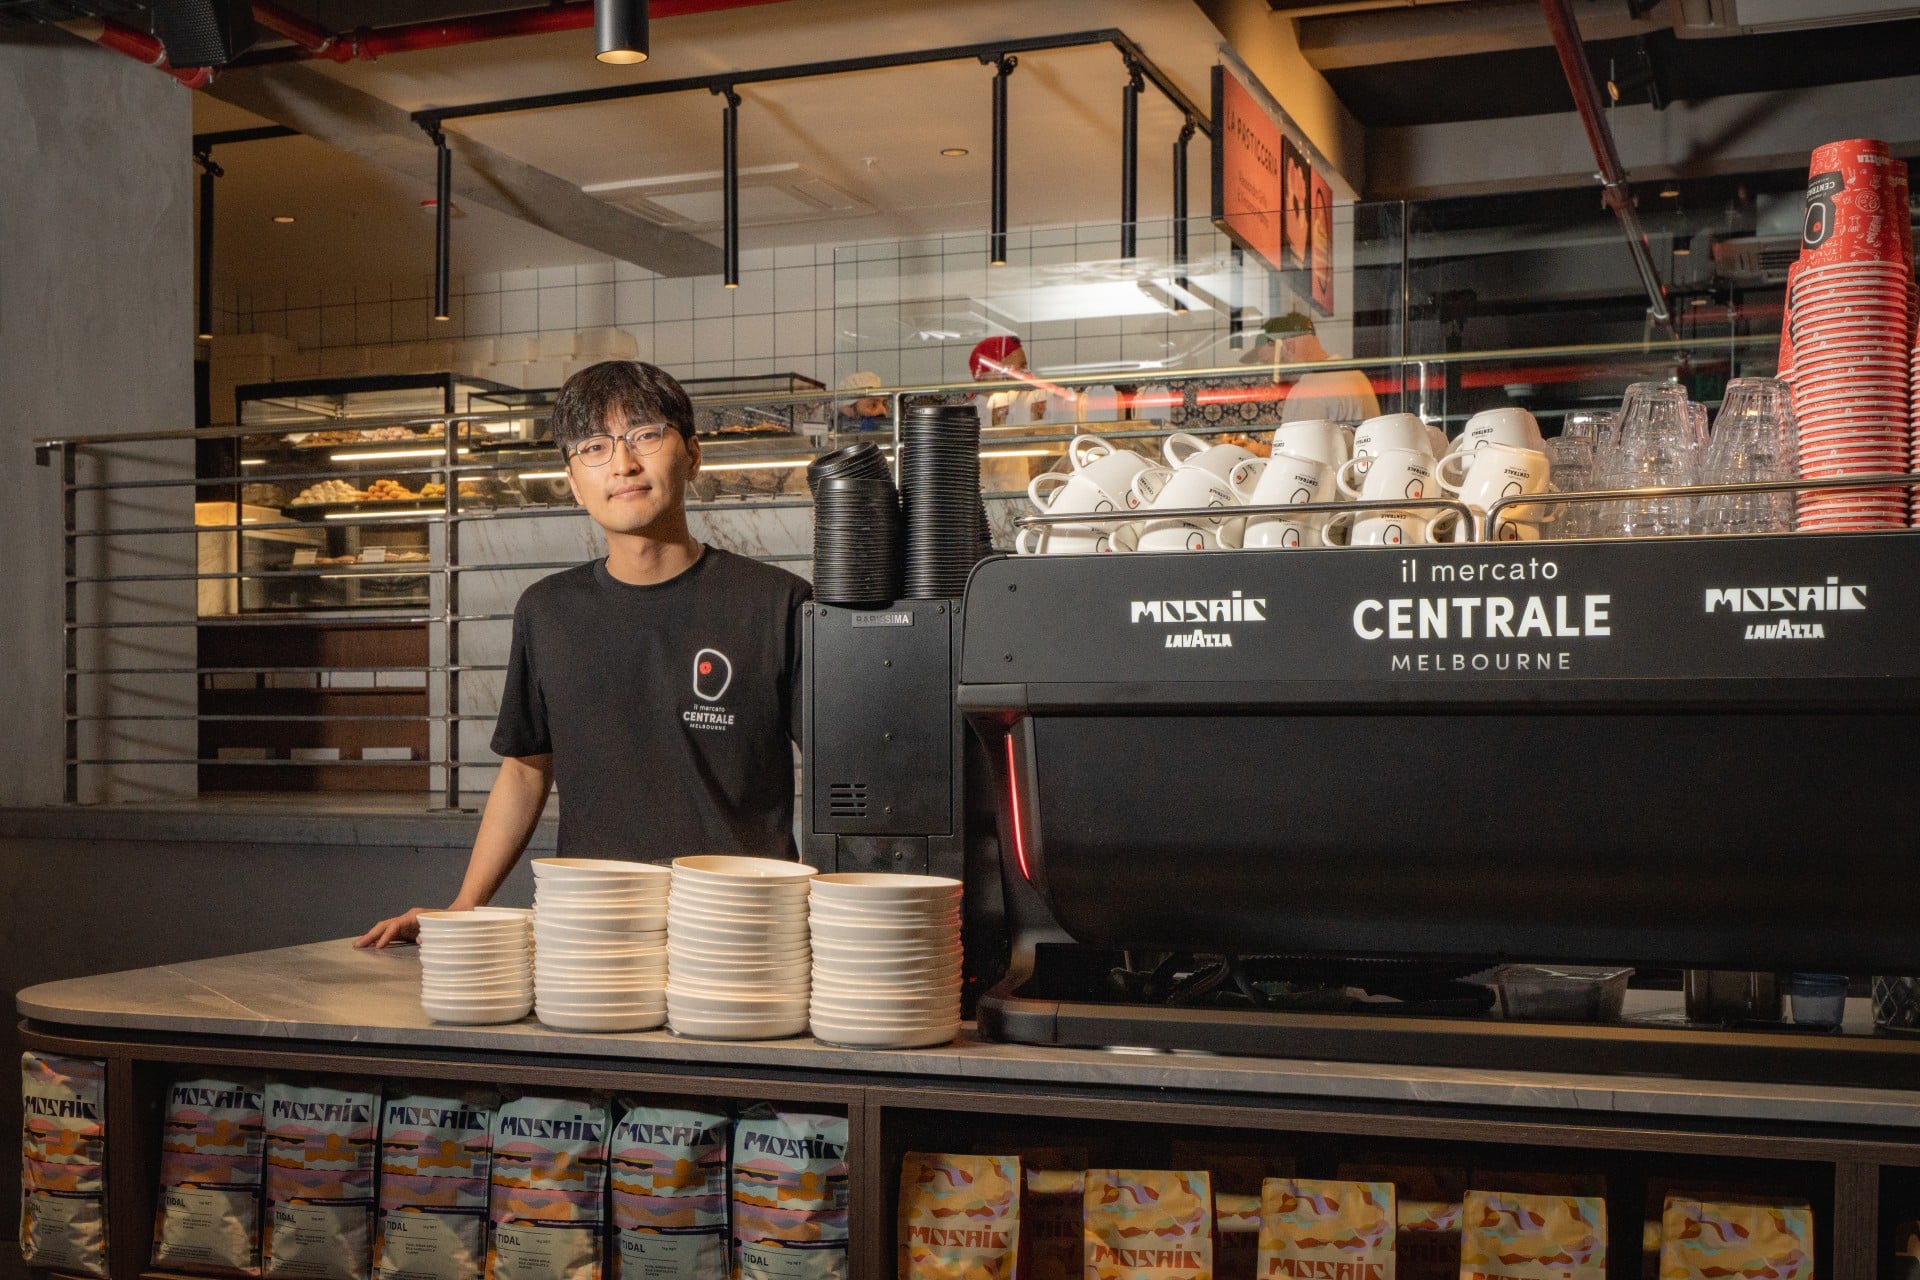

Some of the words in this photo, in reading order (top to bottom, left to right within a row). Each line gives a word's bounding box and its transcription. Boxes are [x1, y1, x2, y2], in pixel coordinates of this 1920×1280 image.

[1504, 468, 1530, 479] CENTRALE
[1295, 475, 1318, 487] CENTRALE
[1402, 559, 1416, 583] il
[1431, 557, 1558, 582] mercato
[856, 614, 909, 624] BARISSIMA
[1353, 594, 1611, 640] CENTRALE
[1744, 619, 1825, 640] LAVAZZA
[1164, 629, 1232, 648] LAVAZZA
[1391, 652, 1571, 671] MELBOURNE
[683, 711, 735, 725] CENTRALE
[690, 723, 726, 731] MELBOURNE
[167, 1196, 186, 1207] TIDAL
[276, 1211, 296, 1224] TIDAL
[386, 1220, 408, 1232] TIDAL
[497, 1233, 521, 1246] TIDAL
[622, 1239, 646, 1253] TIDAL
[743, 1251, 769, 1267] TIDAL
